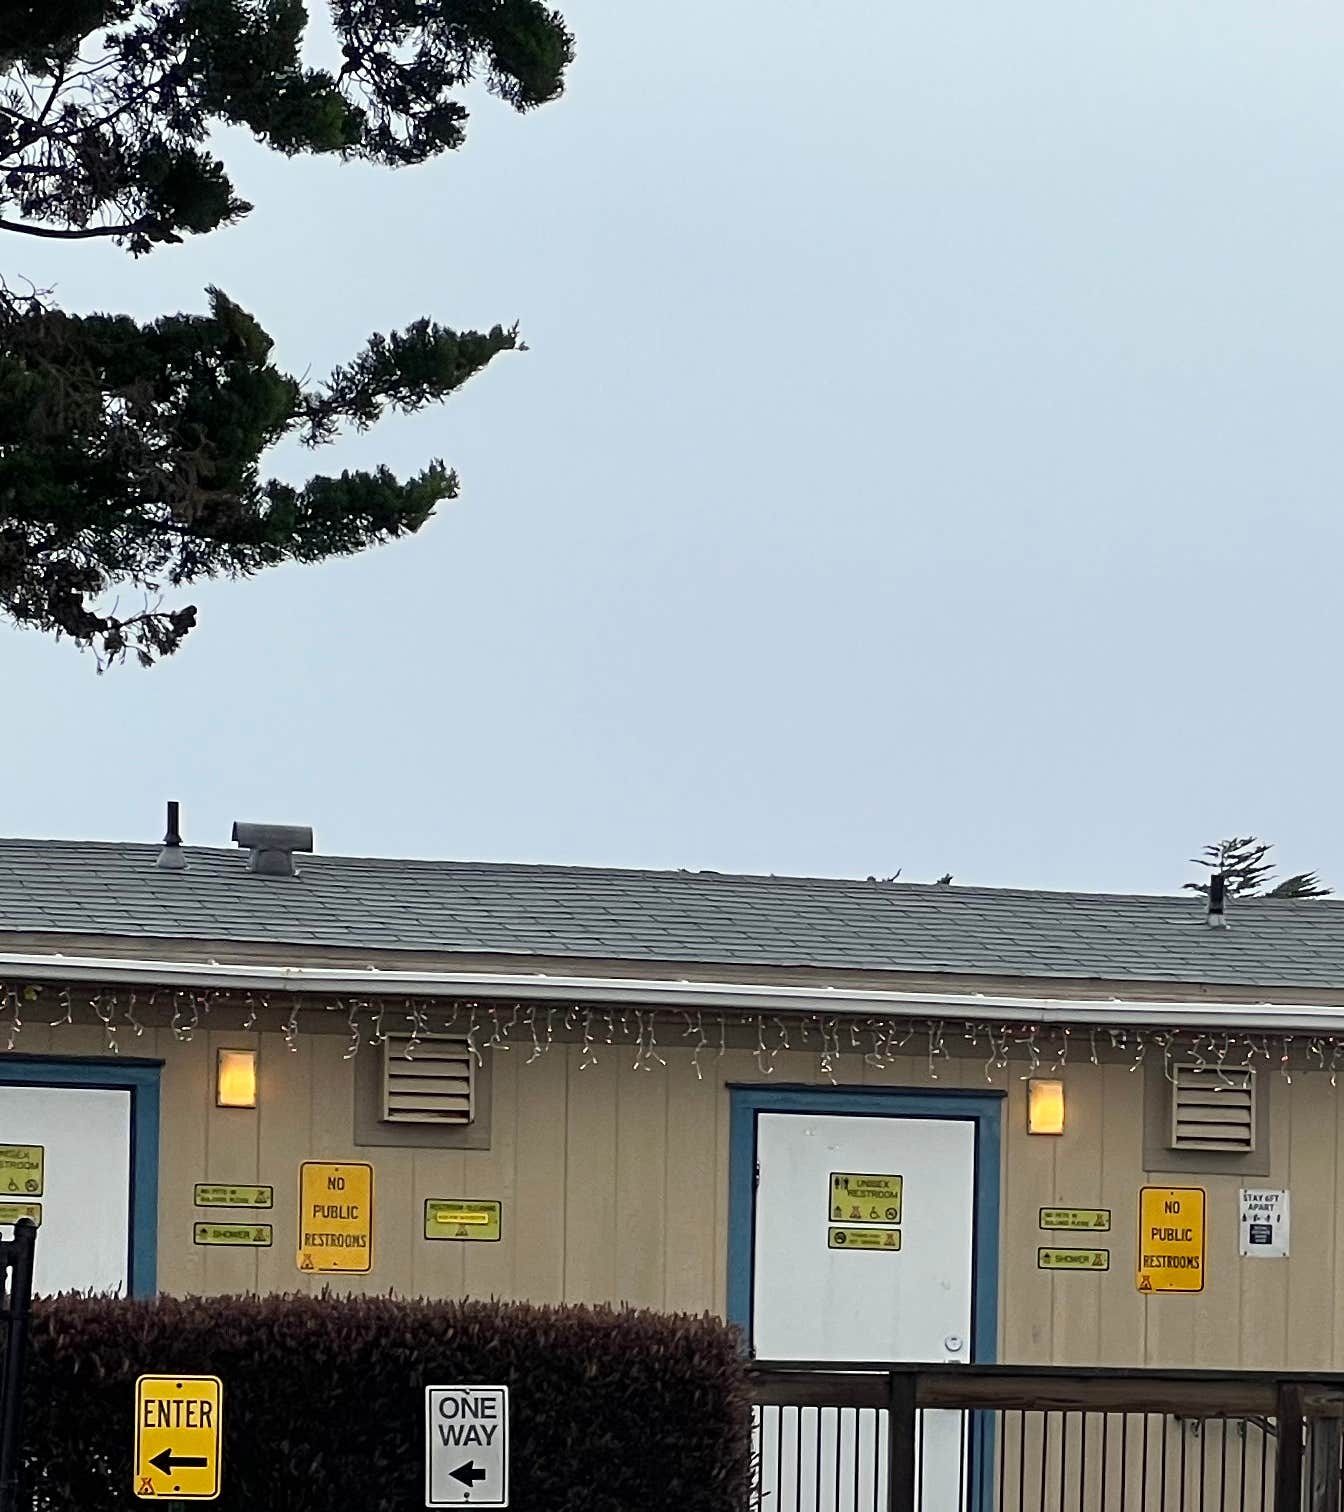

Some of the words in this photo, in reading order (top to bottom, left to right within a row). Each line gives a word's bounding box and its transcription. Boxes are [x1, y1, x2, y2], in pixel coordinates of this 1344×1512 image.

[327, 1177, 345, 1190] NO
[313, 1204, 359, 1219] PUBLIC
[1164, 1201, 1180, 1214] NO
[304, 1233, 367, 1247] RESTROOMS
[1151, 1227, 1193, 1242] PUBLIC
[1143, 1255, 1200, 1269] RESTROOMS
[144, 1399, 212, 1428] ENTER
[439, 1397, 497, 1419] ONE
[438, 1424, 498, 1446] WAY
